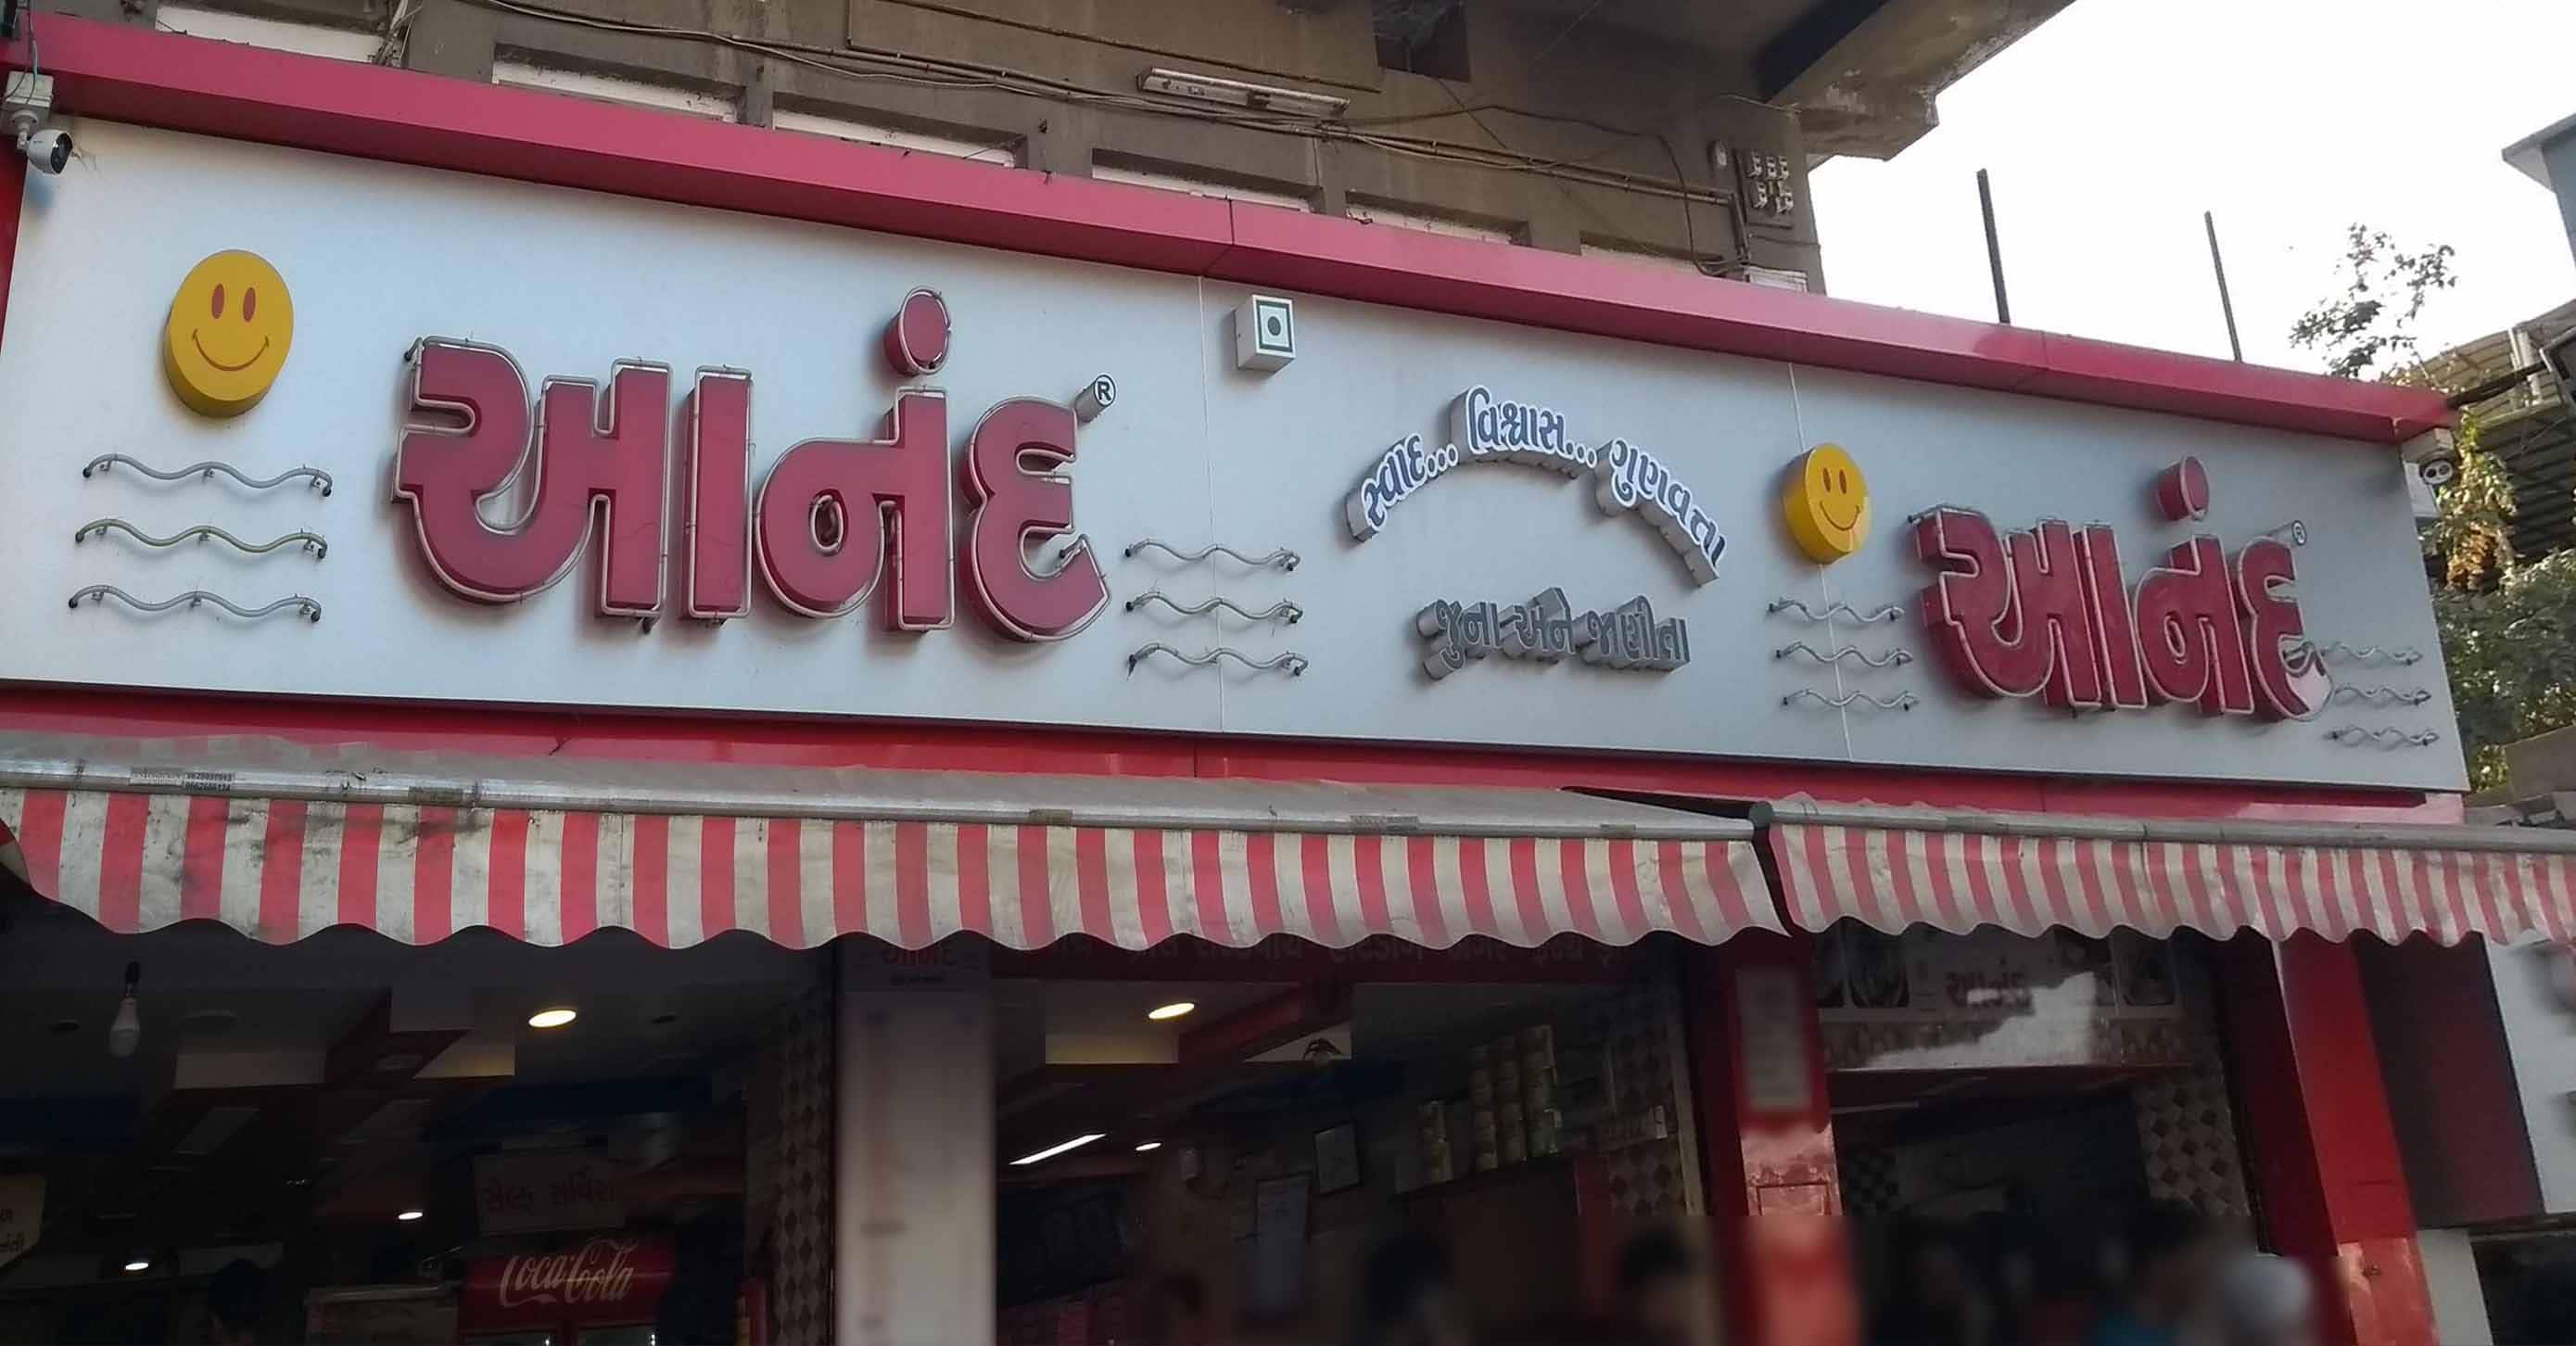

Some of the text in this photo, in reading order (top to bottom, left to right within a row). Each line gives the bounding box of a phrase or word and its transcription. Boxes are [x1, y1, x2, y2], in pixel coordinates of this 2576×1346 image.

[392, 286, 1111, 641] આનંદ
[1919, 454, 2334, 721] આનંદ
[1506, 586, 1576, 654] અને
